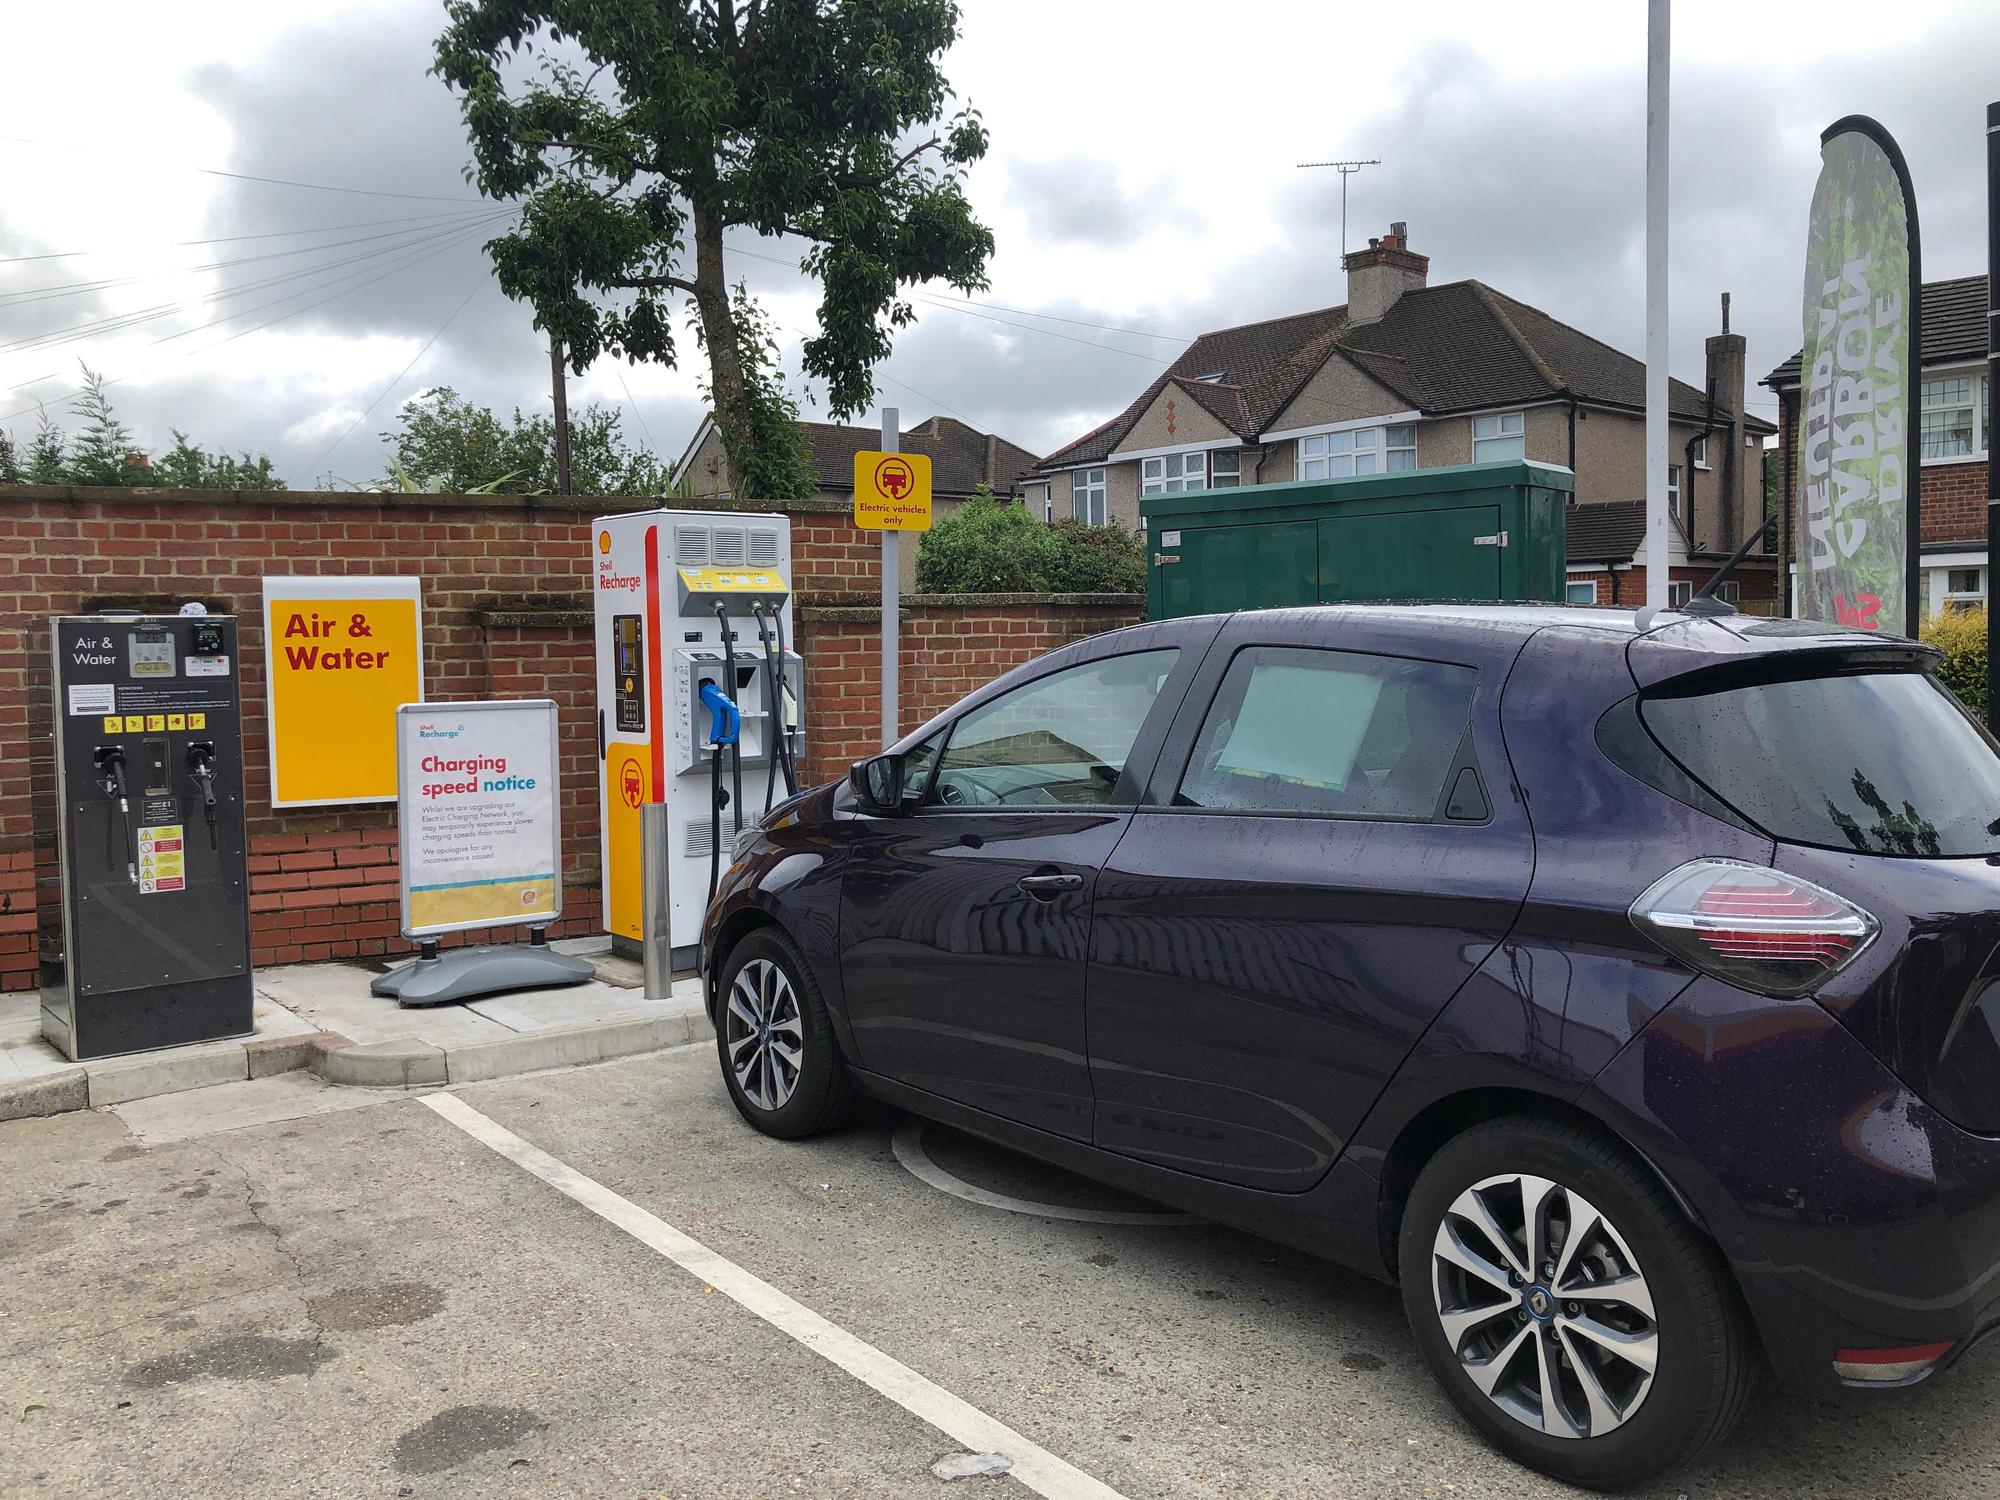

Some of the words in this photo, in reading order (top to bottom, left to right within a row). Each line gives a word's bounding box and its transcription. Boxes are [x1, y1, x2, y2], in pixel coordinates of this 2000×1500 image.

[859, 502, 890, 513] Electric
[892, 504, 927, 514] vehicles
[883, 515, 903, 527] only
[599, 560, 613, 571] Shell
[600, 572, 641, 592] Recharge
[284, 613, 337, 638] Air
[348, 613, 373, 638] &
[75, 637, 97, 649] Air
[102, 636, 114, 649] &
[73, 652, 117, 665] Water
[285, 646, 390, 671] Water
[419, 730, 459, 739] Recharge
[421, 754, 507, 775] Charging
[422, 776, 478, 800] speed
[484, 774, 536, 792] notice
[422, 805, 443, 813] Whilst
[469, 803, 503, 812] upgrading
[447, 813, 478, 821] Charging
[438, 822, 475, 831] temporarily
[476, 820, 513, 829] experience
[514, 817, 534, 825] slower
[422, 833, 452, 841] charging
[454, 831, 476, 839] speeds
[478, 829, 492, 837] than
[436, 846, 469, 855] apologise
[422, 856, 470, 864] inconvenience
